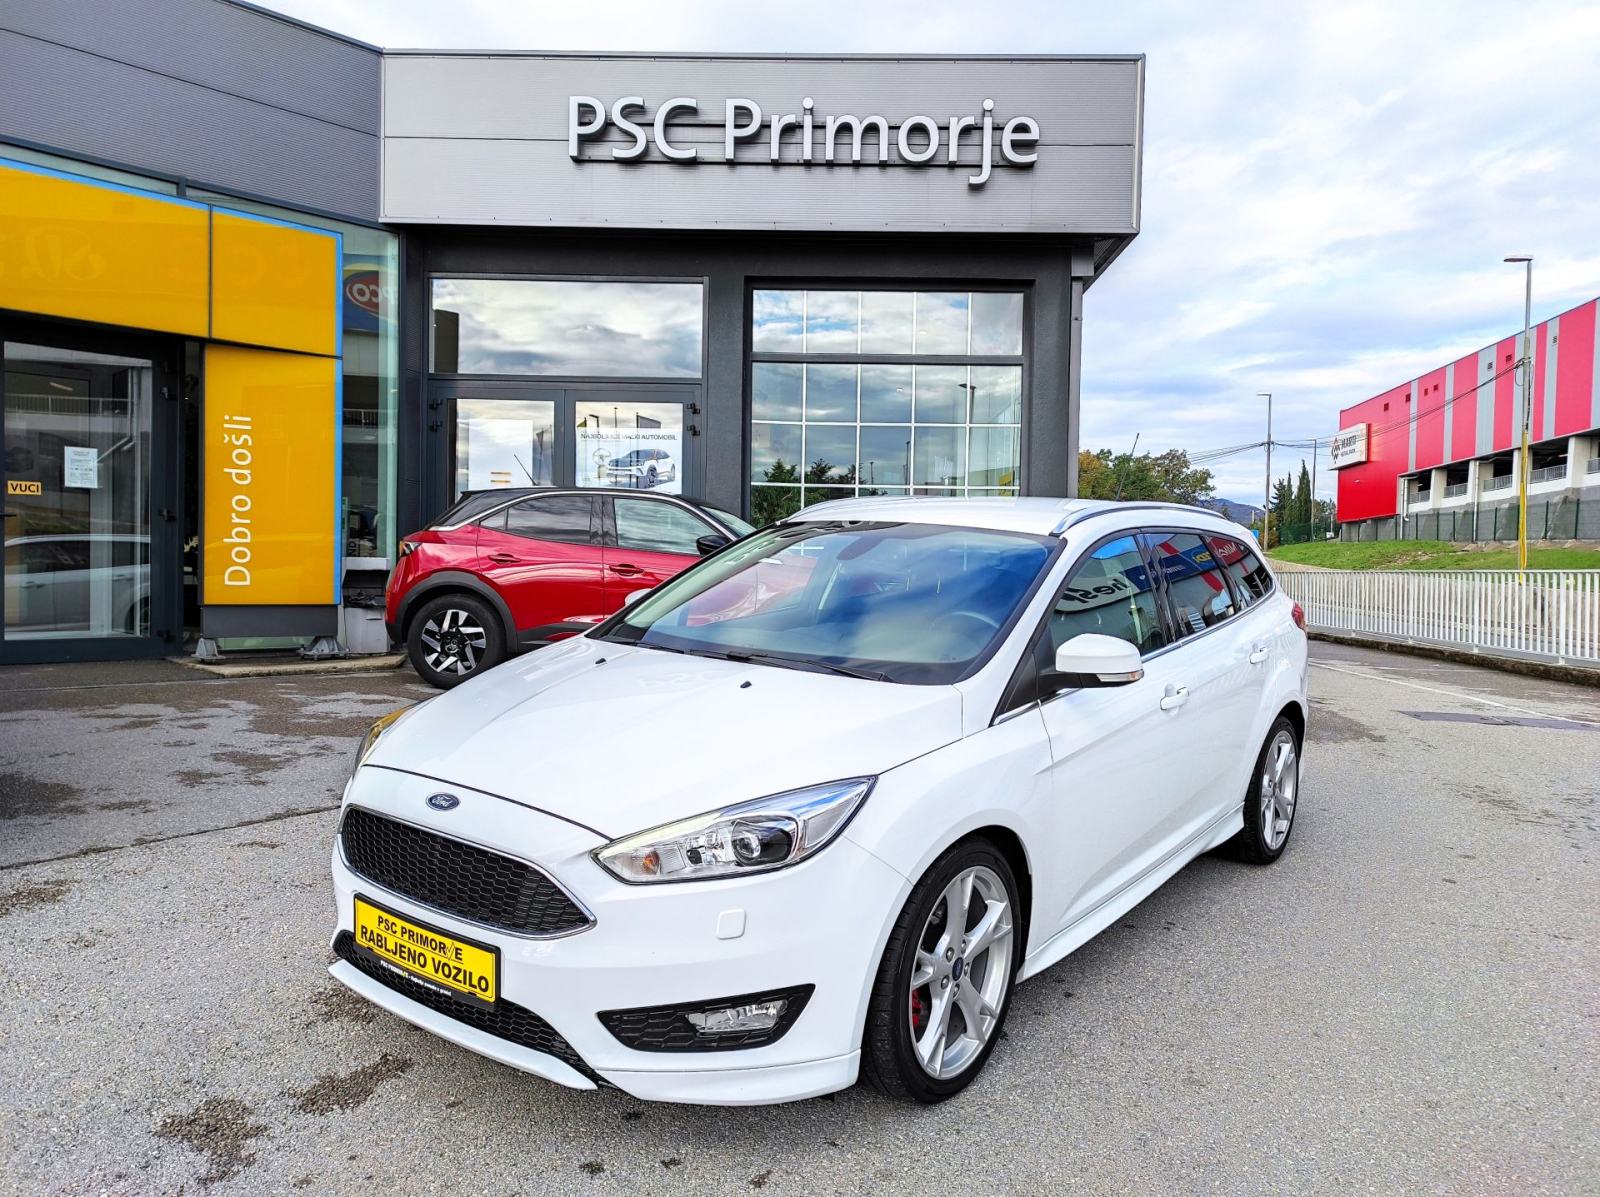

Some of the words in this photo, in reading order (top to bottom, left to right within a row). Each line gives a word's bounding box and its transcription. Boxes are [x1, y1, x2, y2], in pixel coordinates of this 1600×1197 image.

[568, 95, 698, 163] PSC
[724, 97, 1040, 188] Primorje
[223, 415, 252, 485] došli
[641, 433, 677, 441] AUTOMOBIL
[10, 482, 39, 493] VUCI
[223, 494, 252, 586] Dobro
[360, 924, 428, 969] RABLJENO
[431, 956, 489, 993] VOZILO
[377, 915, 398, 934] PSC
